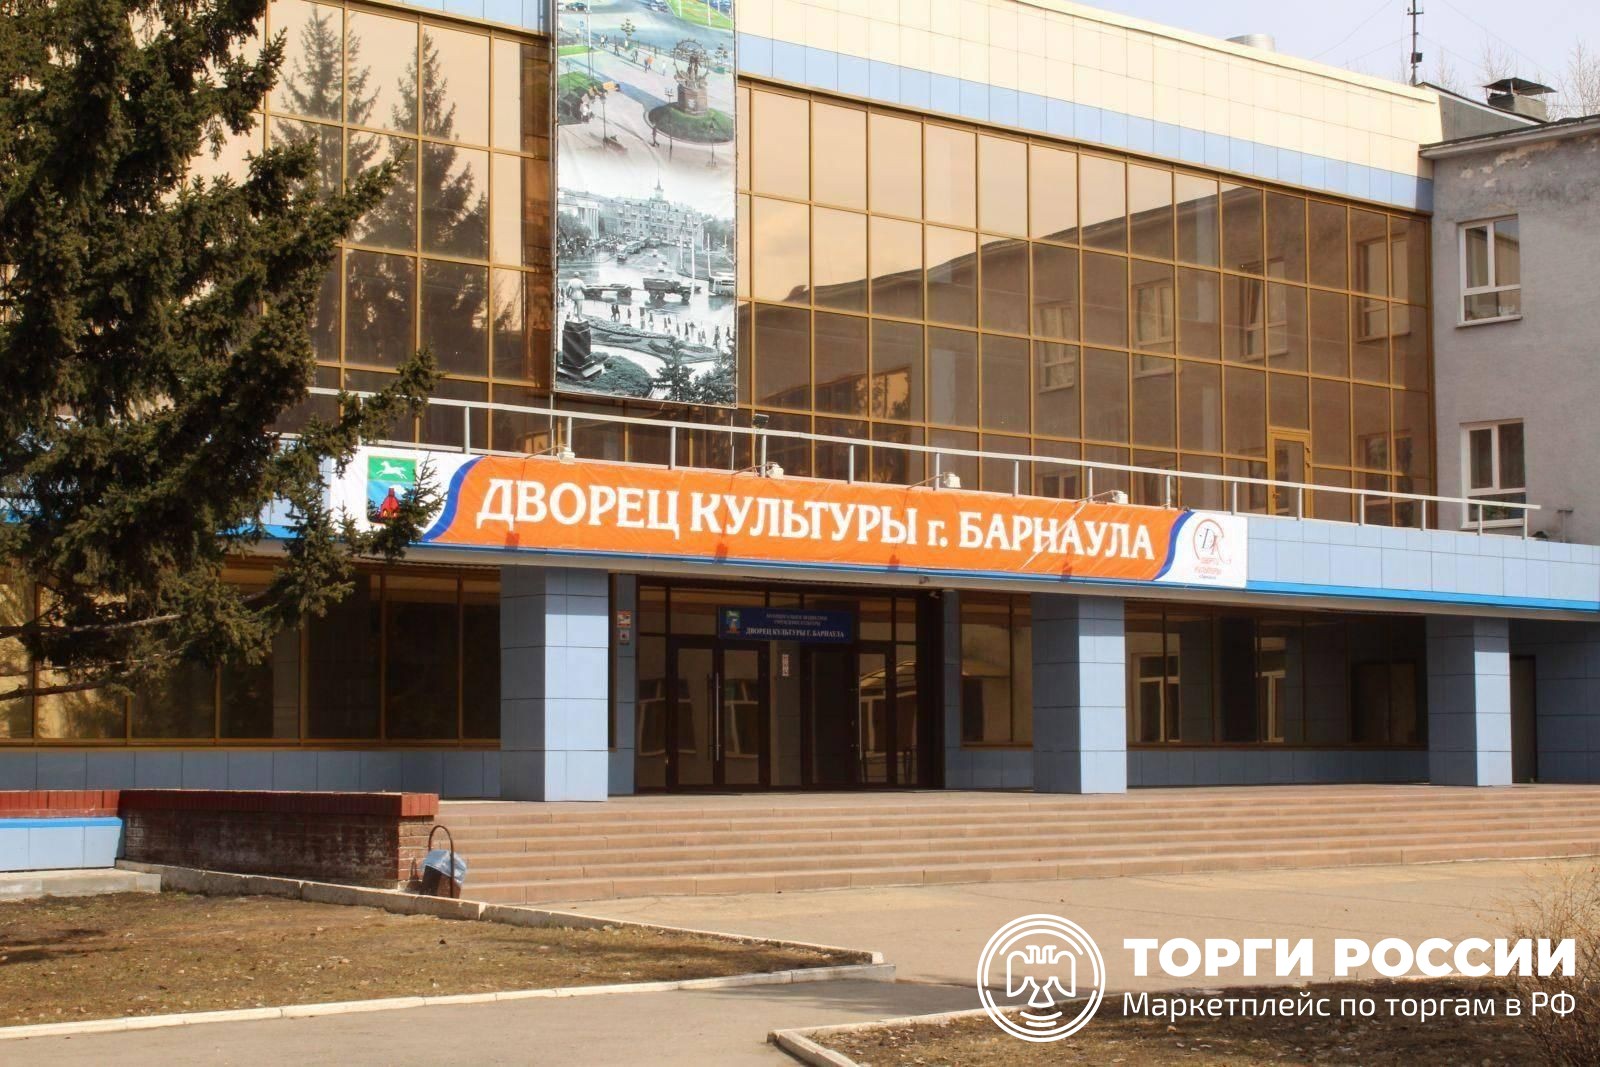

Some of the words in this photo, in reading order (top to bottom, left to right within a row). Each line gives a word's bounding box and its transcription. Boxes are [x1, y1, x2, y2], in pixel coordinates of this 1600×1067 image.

[476, 478, 680, 540] ДВОРЕЦ
[690, 491, 918, 545] КУЛЬТУРЫ
[927, 519, 949, 548] г.
[959, 511, 1155, 561] БАРНАУЛА
